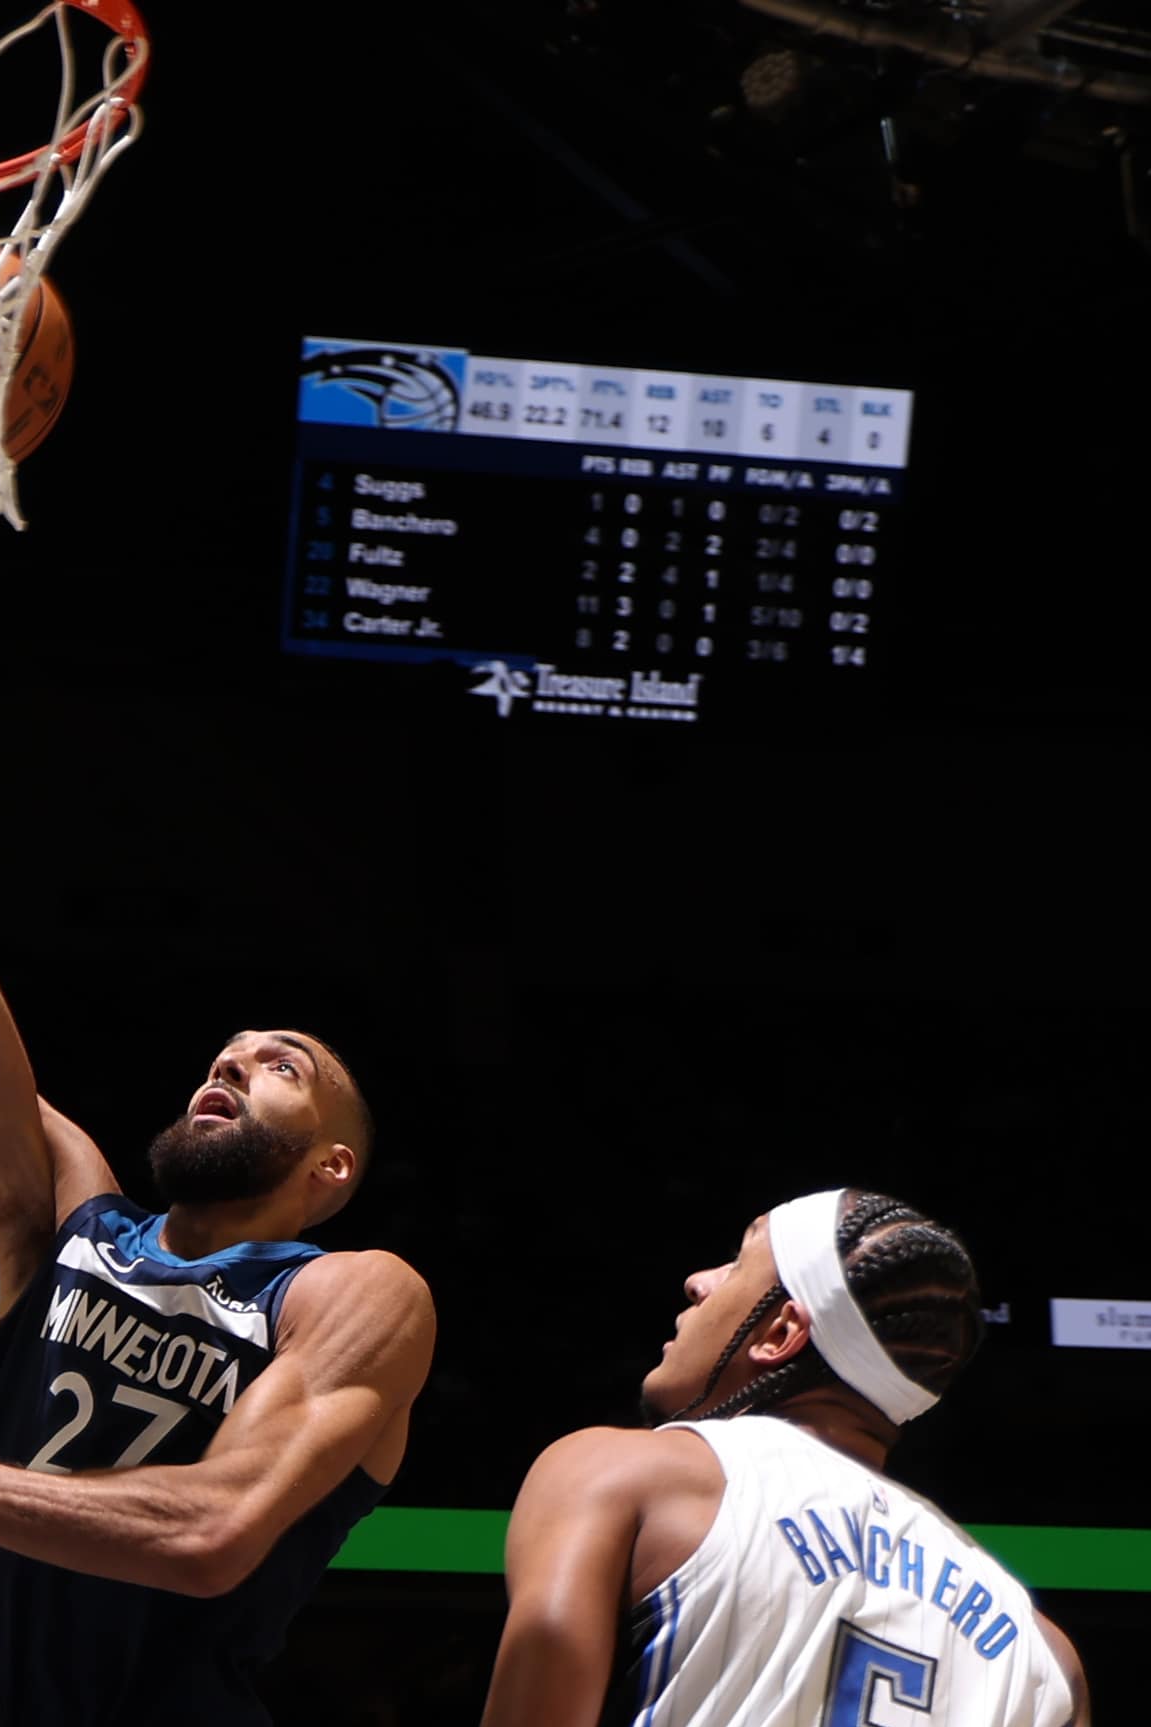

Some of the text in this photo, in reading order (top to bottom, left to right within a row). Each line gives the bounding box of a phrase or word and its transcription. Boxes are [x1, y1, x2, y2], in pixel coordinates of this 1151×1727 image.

[525, 404, 568, 426] 22.2
[580, 408, 623, 429] 71.4
[648, 414, 669, 433] 12
[703, 419, 725, 439] 10
[818, 427, 832, 446] 4
[354, 474, 425, 502] Suggs
[624, 493, 642, 514] 0
[708, 500, 726, 521] 0
[351, 508, 457, 535] Banchero
[621, 527, 639, 548] 0
[705, 534, 723, 555] 2
[345, 577, 430, 605] Wagner
[616, 596, 632, 617] 3
[618, 561, 636, 583] 2
[704, 569, 719, 588] 1
[343, 611, 414, 636] Carter
[612, 629, 630, 651] 2
[696, 636, 713, 656] 0
[533, 663, 701, 706] Treasure Island
[40, 1284, 240, 1416] MINNESOTA
[26, 1371, 191, 1475] 27
